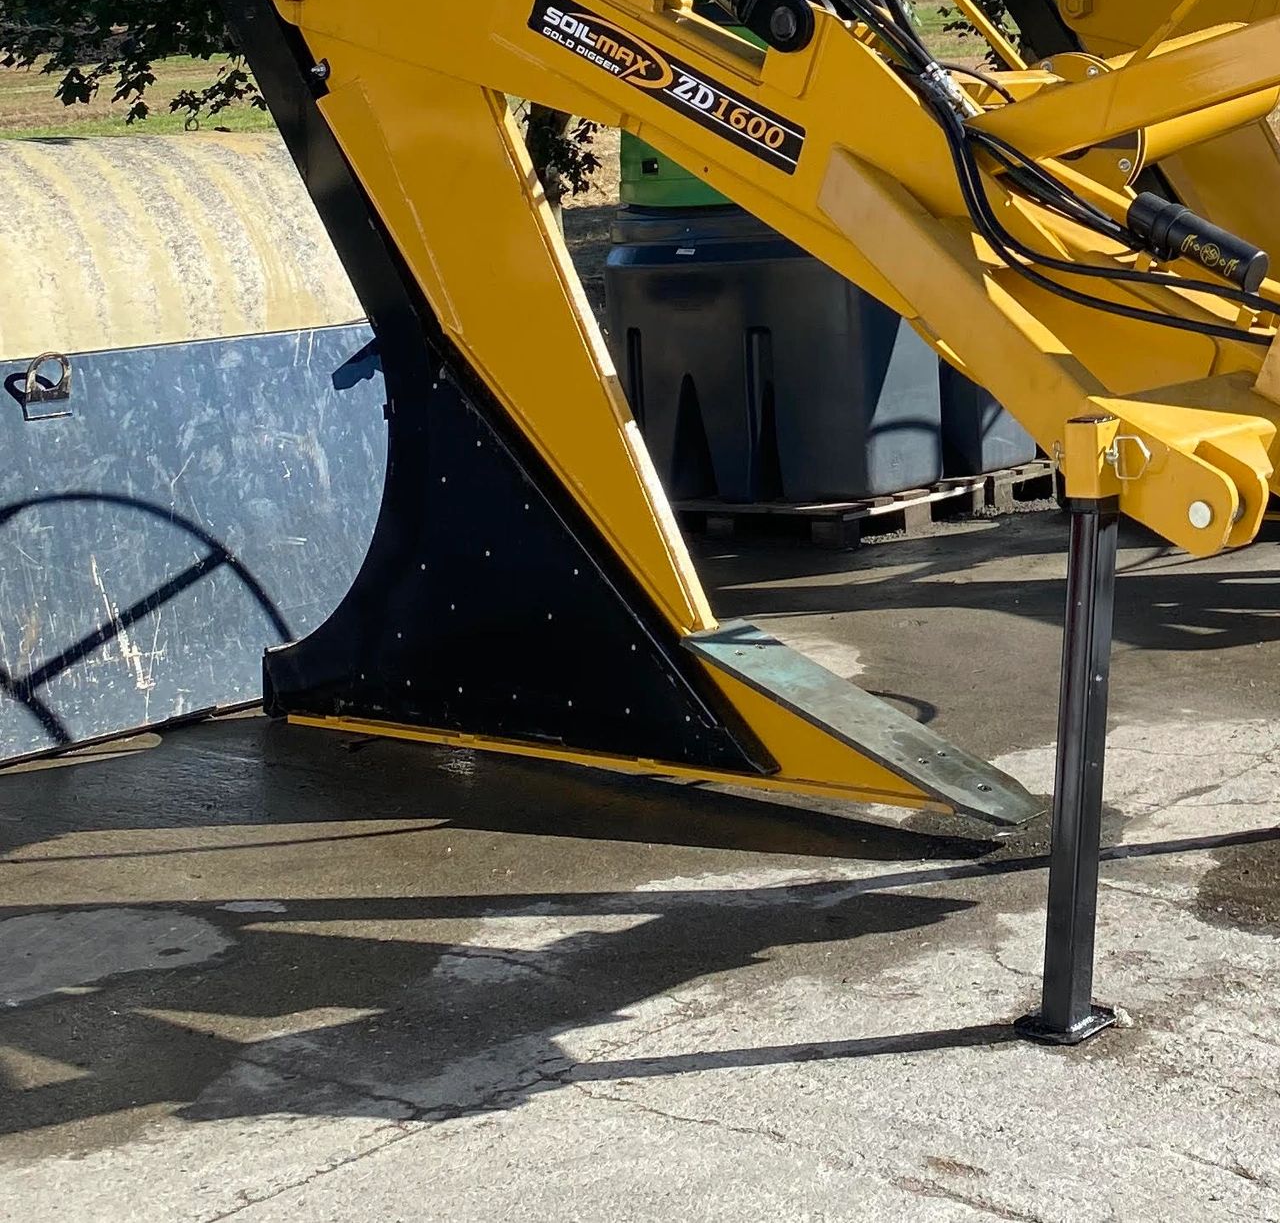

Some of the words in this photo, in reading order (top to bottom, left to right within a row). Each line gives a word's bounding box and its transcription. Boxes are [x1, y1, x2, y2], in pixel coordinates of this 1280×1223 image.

[542, 26, 576, 49] GOLD
[575, 45, 622, 75] DIGGER
[543, 6, 652, 78] SOIL-MAX
[672, 75, 785, 149] ZD1600
